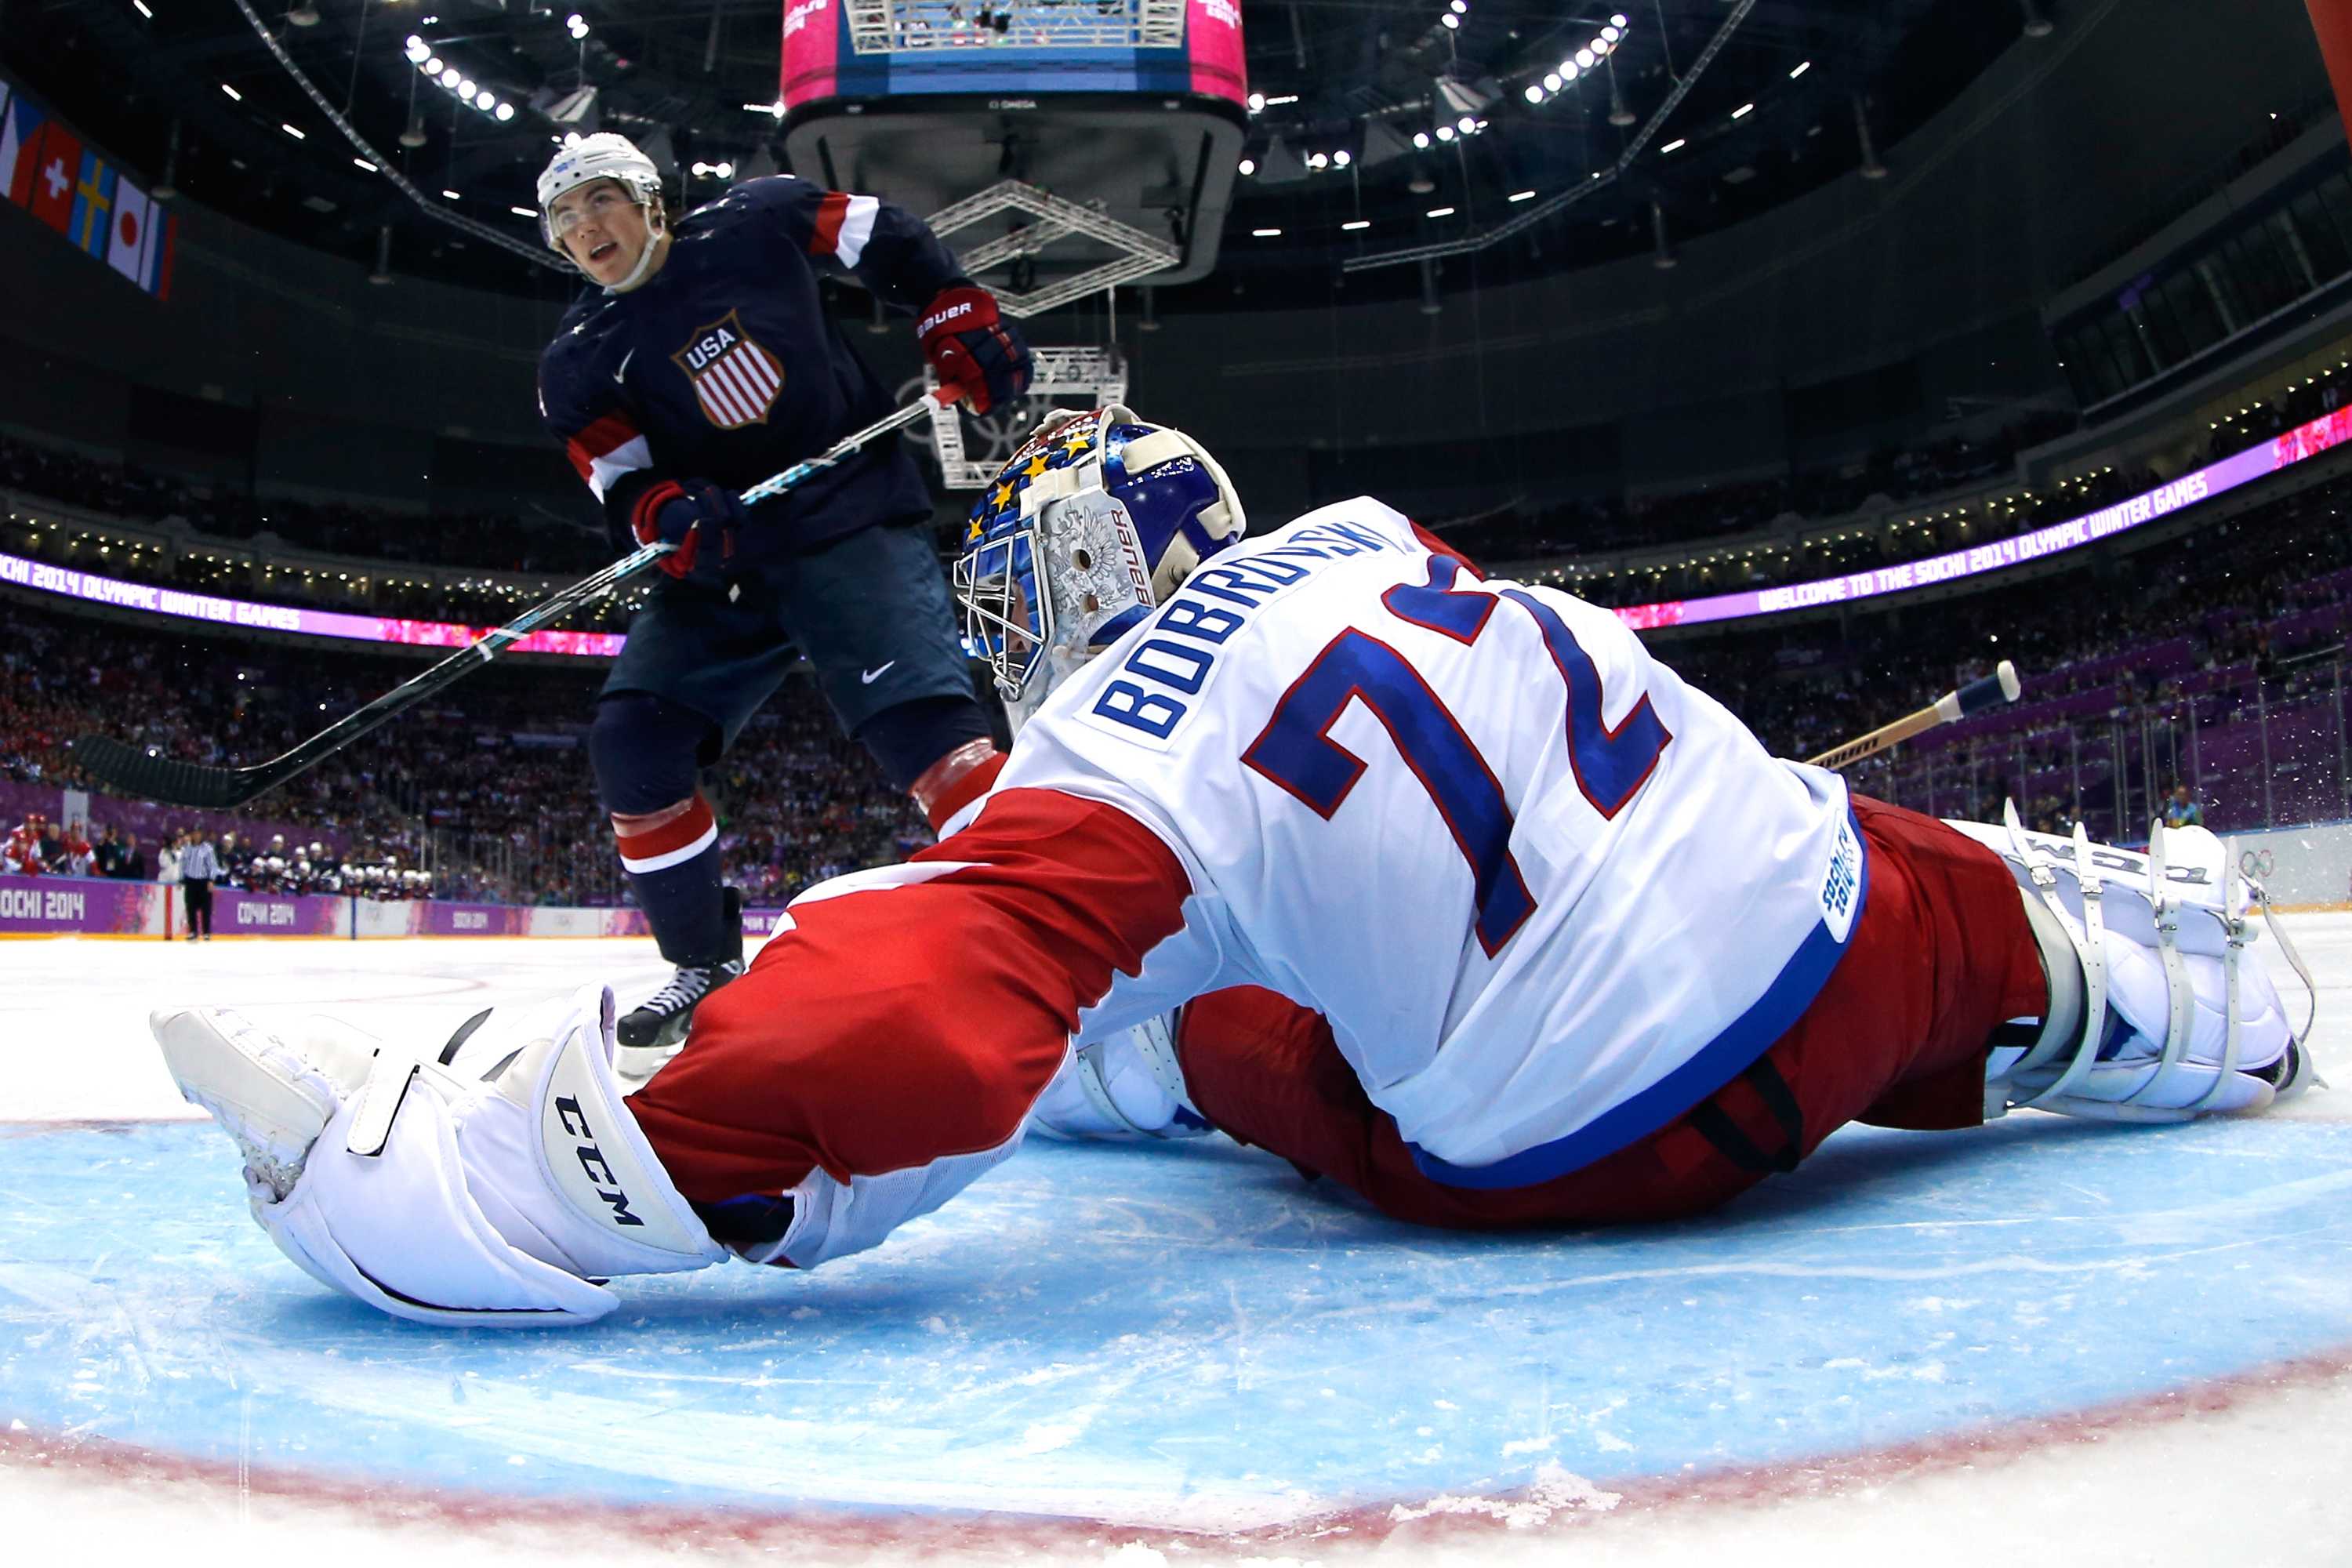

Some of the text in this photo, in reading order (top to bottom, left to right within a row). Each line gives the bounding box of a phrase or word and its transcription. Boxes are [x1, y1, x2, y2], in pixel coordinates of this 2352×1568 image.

[686, 328, 735, 369] USA
[0, 554, 300, 630] CHI 2014 OLYMPIC WINTER GAMES
[1759, 471, 2209, 612] WELCOME TO THE SOCHI 2014 OLYMPIC WINTER GAMES
[1240, 552, 1673, 960] 72
[45, 891, 85, 920] 2014
[555, 1093, 645, 1226] CCM
